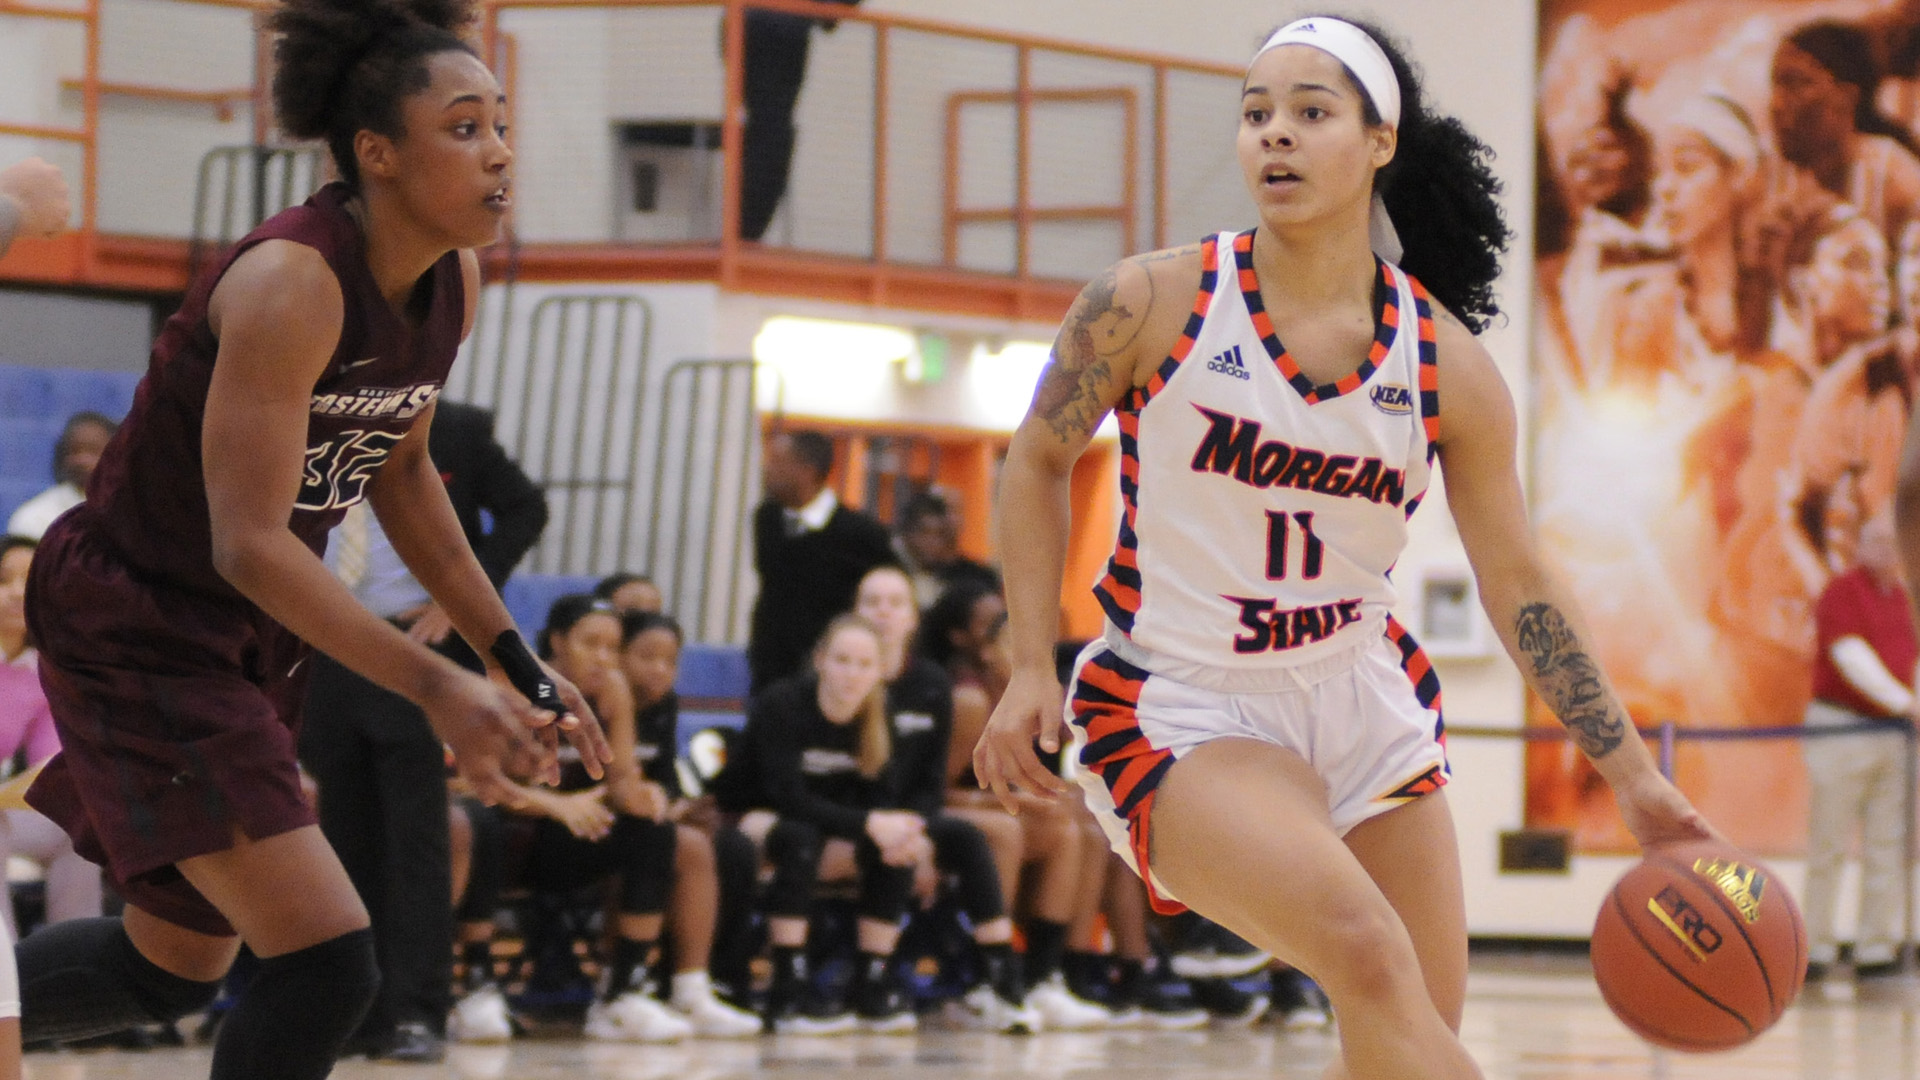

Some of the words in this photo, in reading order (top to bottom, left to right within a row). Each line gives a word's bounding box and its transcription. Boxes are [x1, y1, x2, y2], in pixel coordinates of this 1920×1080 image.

[1207, 360, 1250, 381] adidas
[1188, 401, 1407, 509] MORGAN
[1264, 509, 1324, 580] 11
[1218, 592, 1363, 655] STATE
[1654, 884, 1723, 954] PRO
